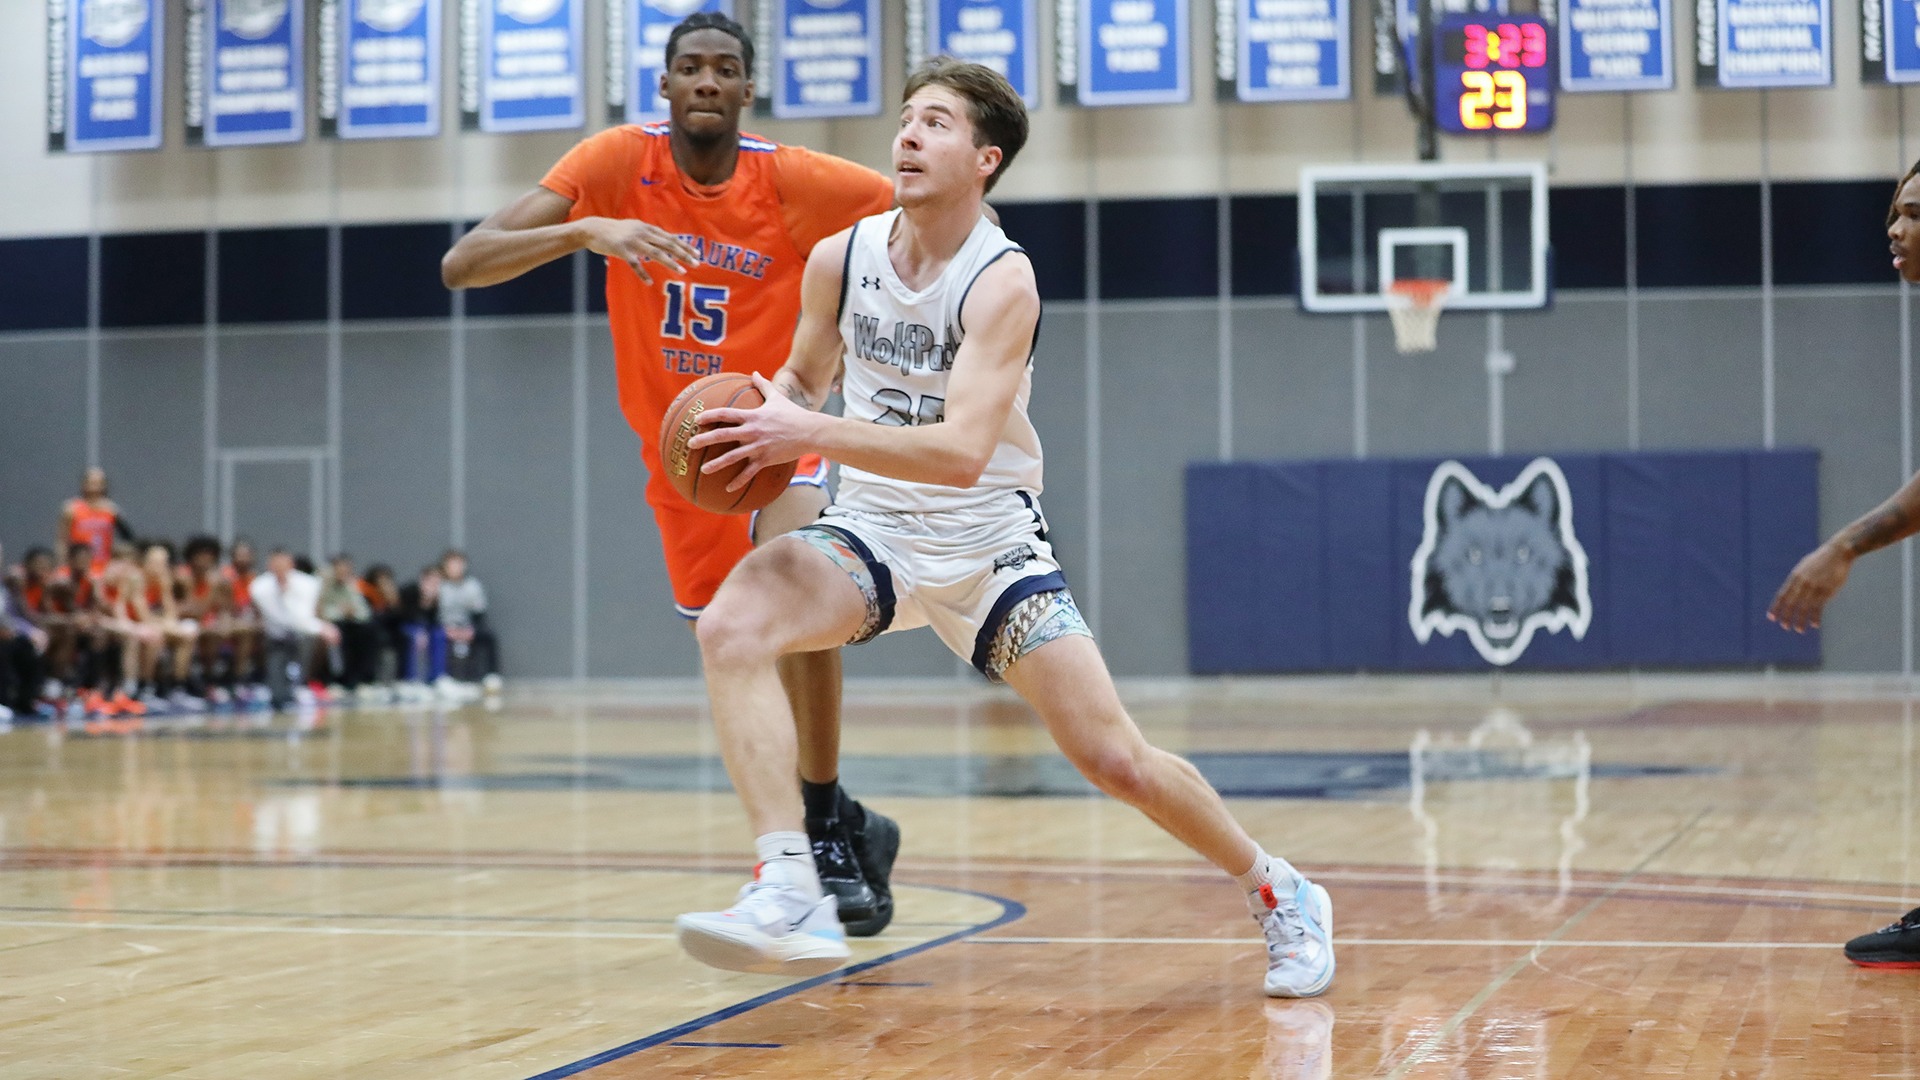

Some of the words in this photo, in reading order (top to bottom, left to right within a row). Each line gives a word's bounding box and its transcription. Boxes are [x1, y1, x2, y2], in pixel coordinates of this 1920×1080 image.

[1463, 23, 1547, 69] 3:23
[1460, 70, 1527, 130] 23
[640, 233, 773, 280] AUKEE
[660, 280, 730, 347] 15
[661, 348, 723, 376] TECH
